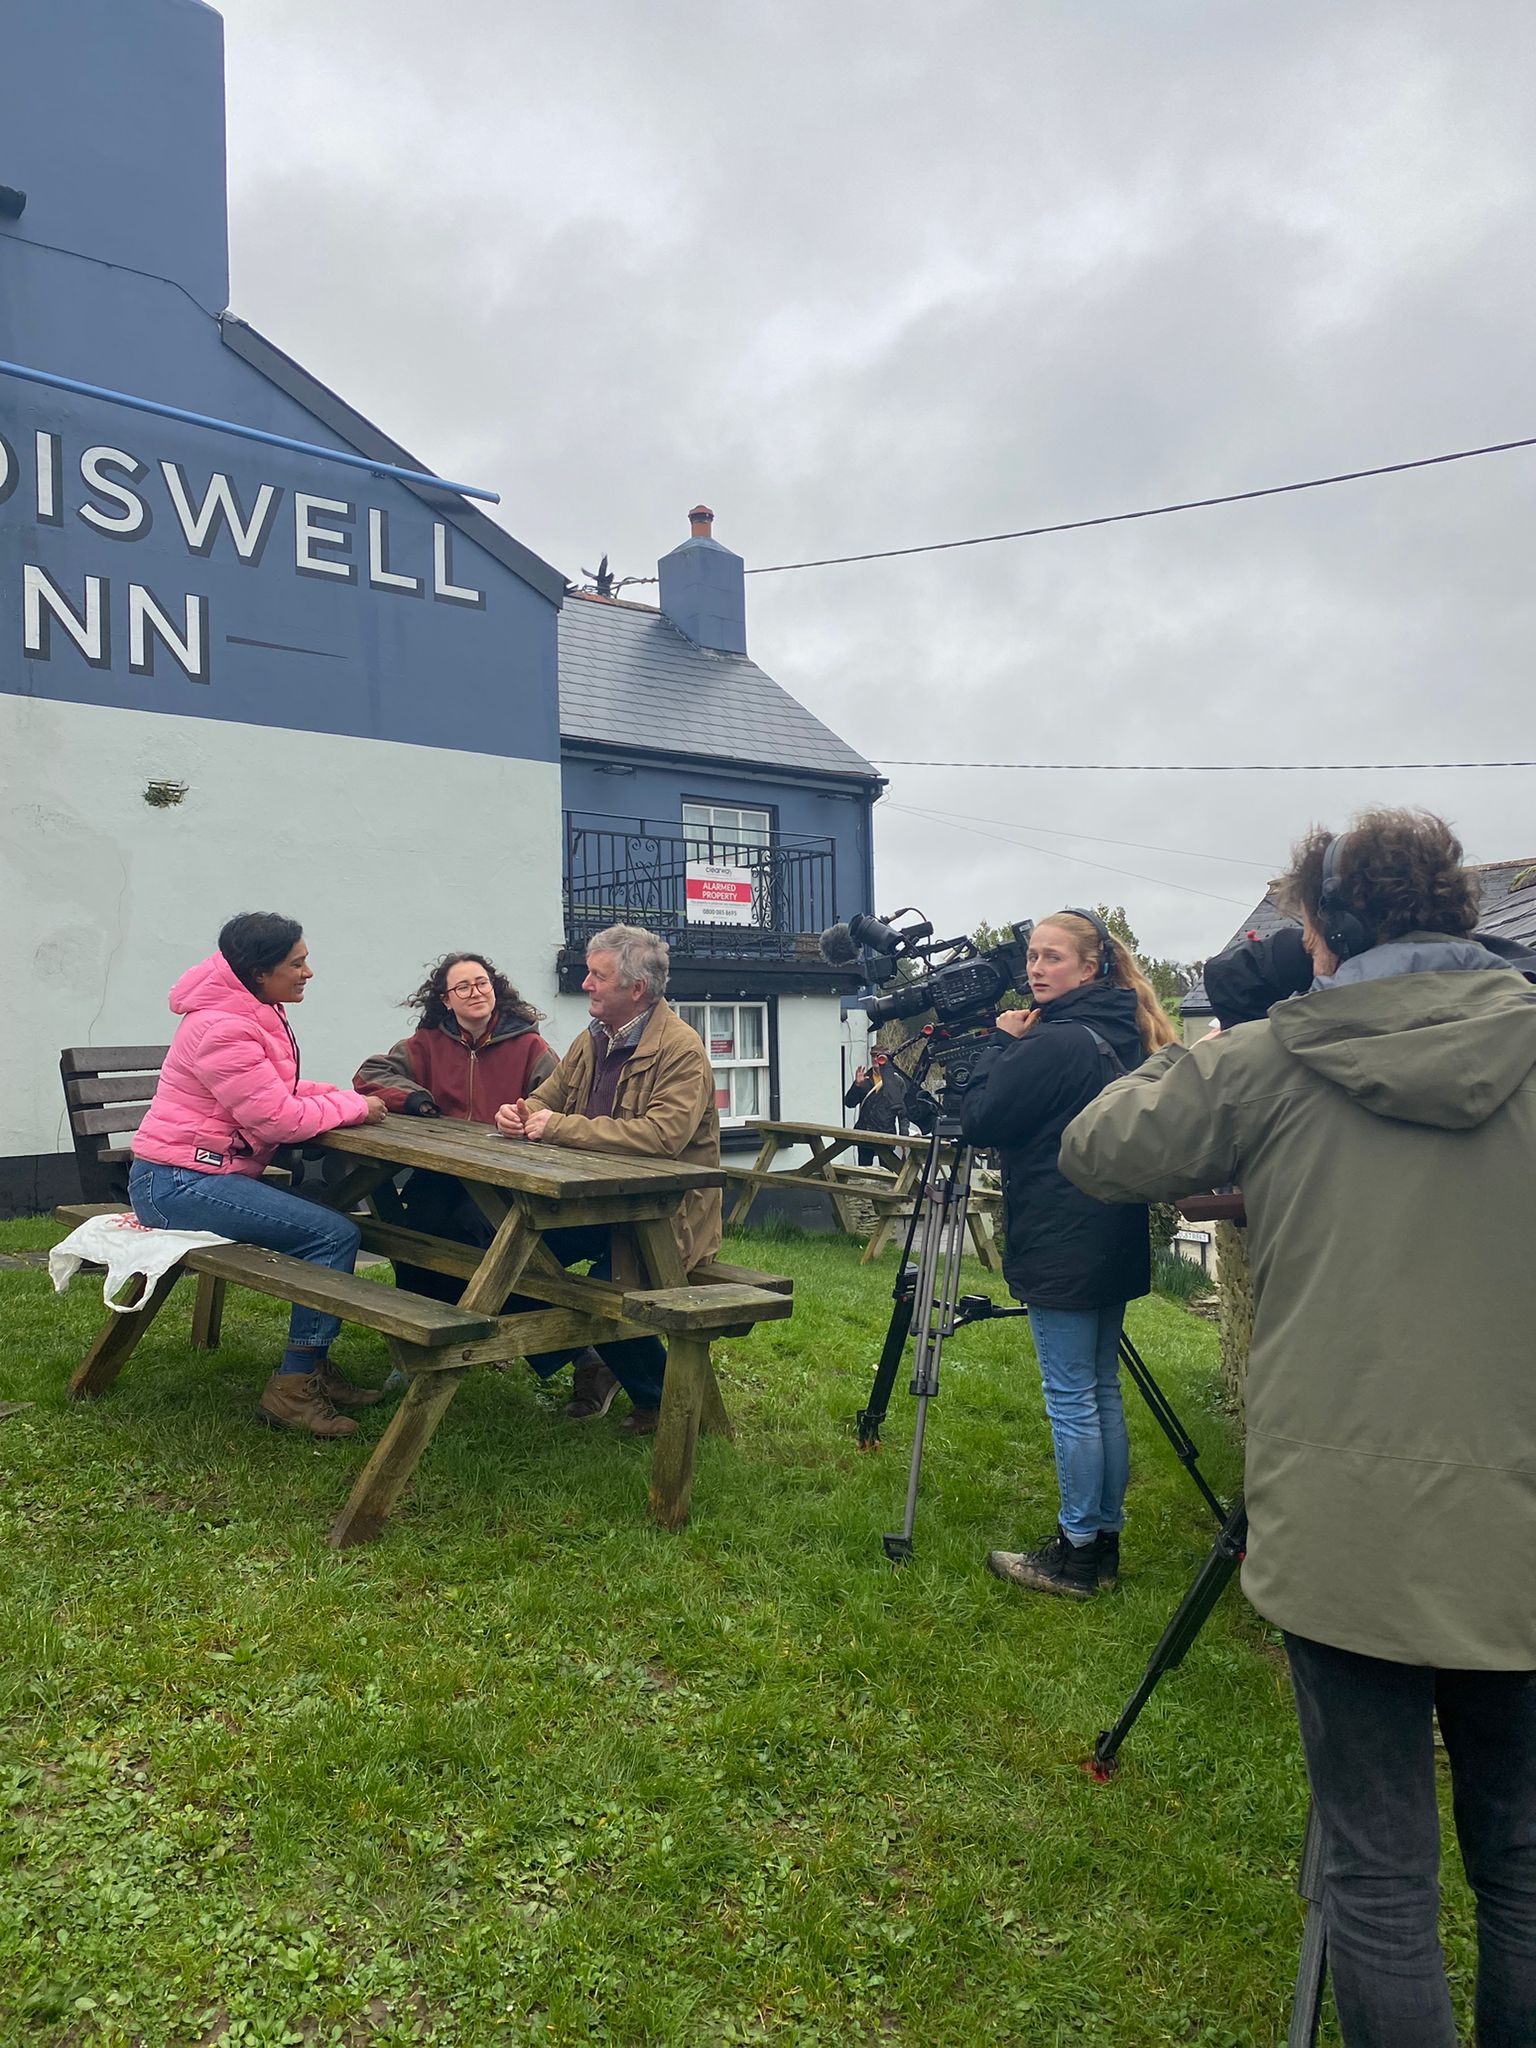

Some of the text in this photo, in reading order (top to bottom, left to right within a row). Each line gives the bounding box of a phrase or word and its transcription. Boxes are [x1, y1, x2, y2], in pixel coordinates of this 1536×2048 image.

[0, 429, 484, 607] ISWELL
[702, 882, 736, 891] ALARMED
[702, 891, 737, 900] PROPERTY
